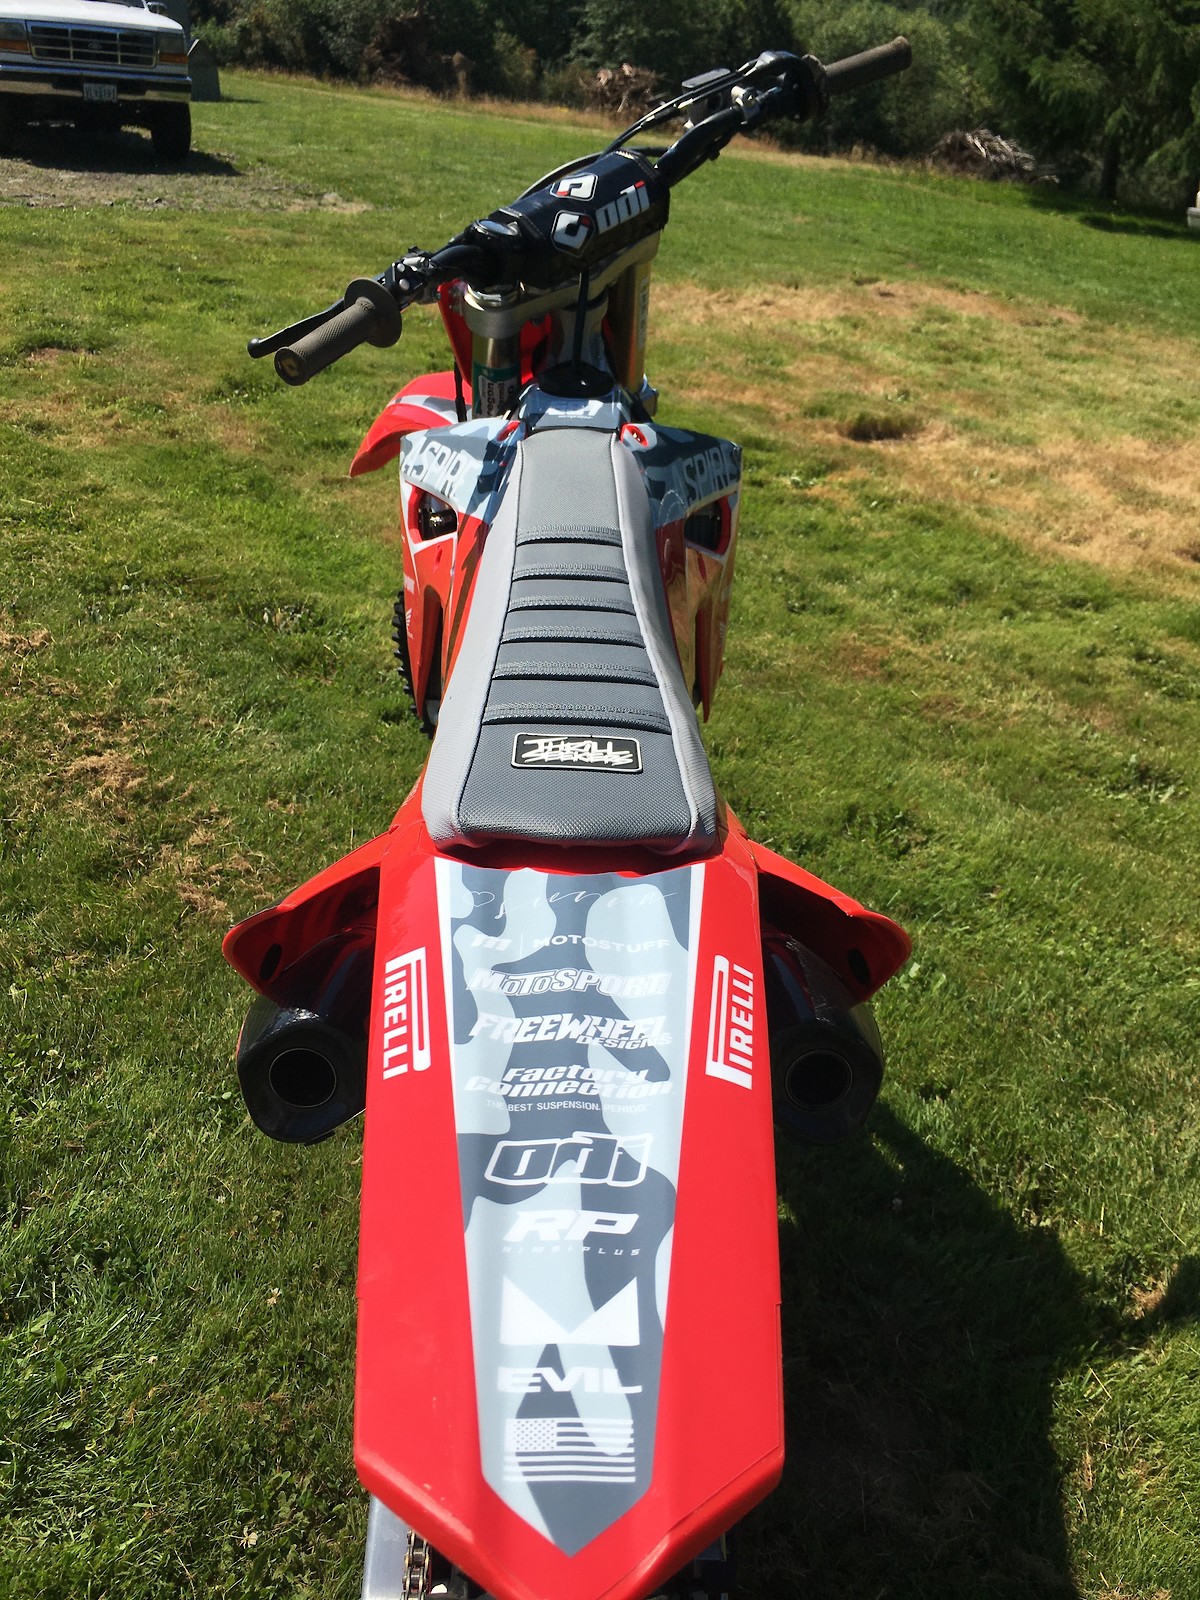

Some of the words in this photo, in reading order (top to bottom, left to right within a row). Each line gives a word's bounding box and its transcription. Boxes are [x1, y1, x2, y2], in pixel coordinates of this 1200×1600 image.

[533, 934, 671, 953] MOTOSTUFF
[383, 946, 431, 1080] PIRELLI
[705, 955, 753, 1090] PIRELLI
[508, 1102, 533, 1112] BEST
[502, 1208, 639, 1242] RP
[497, 1366, 642, 1393] EVIL
